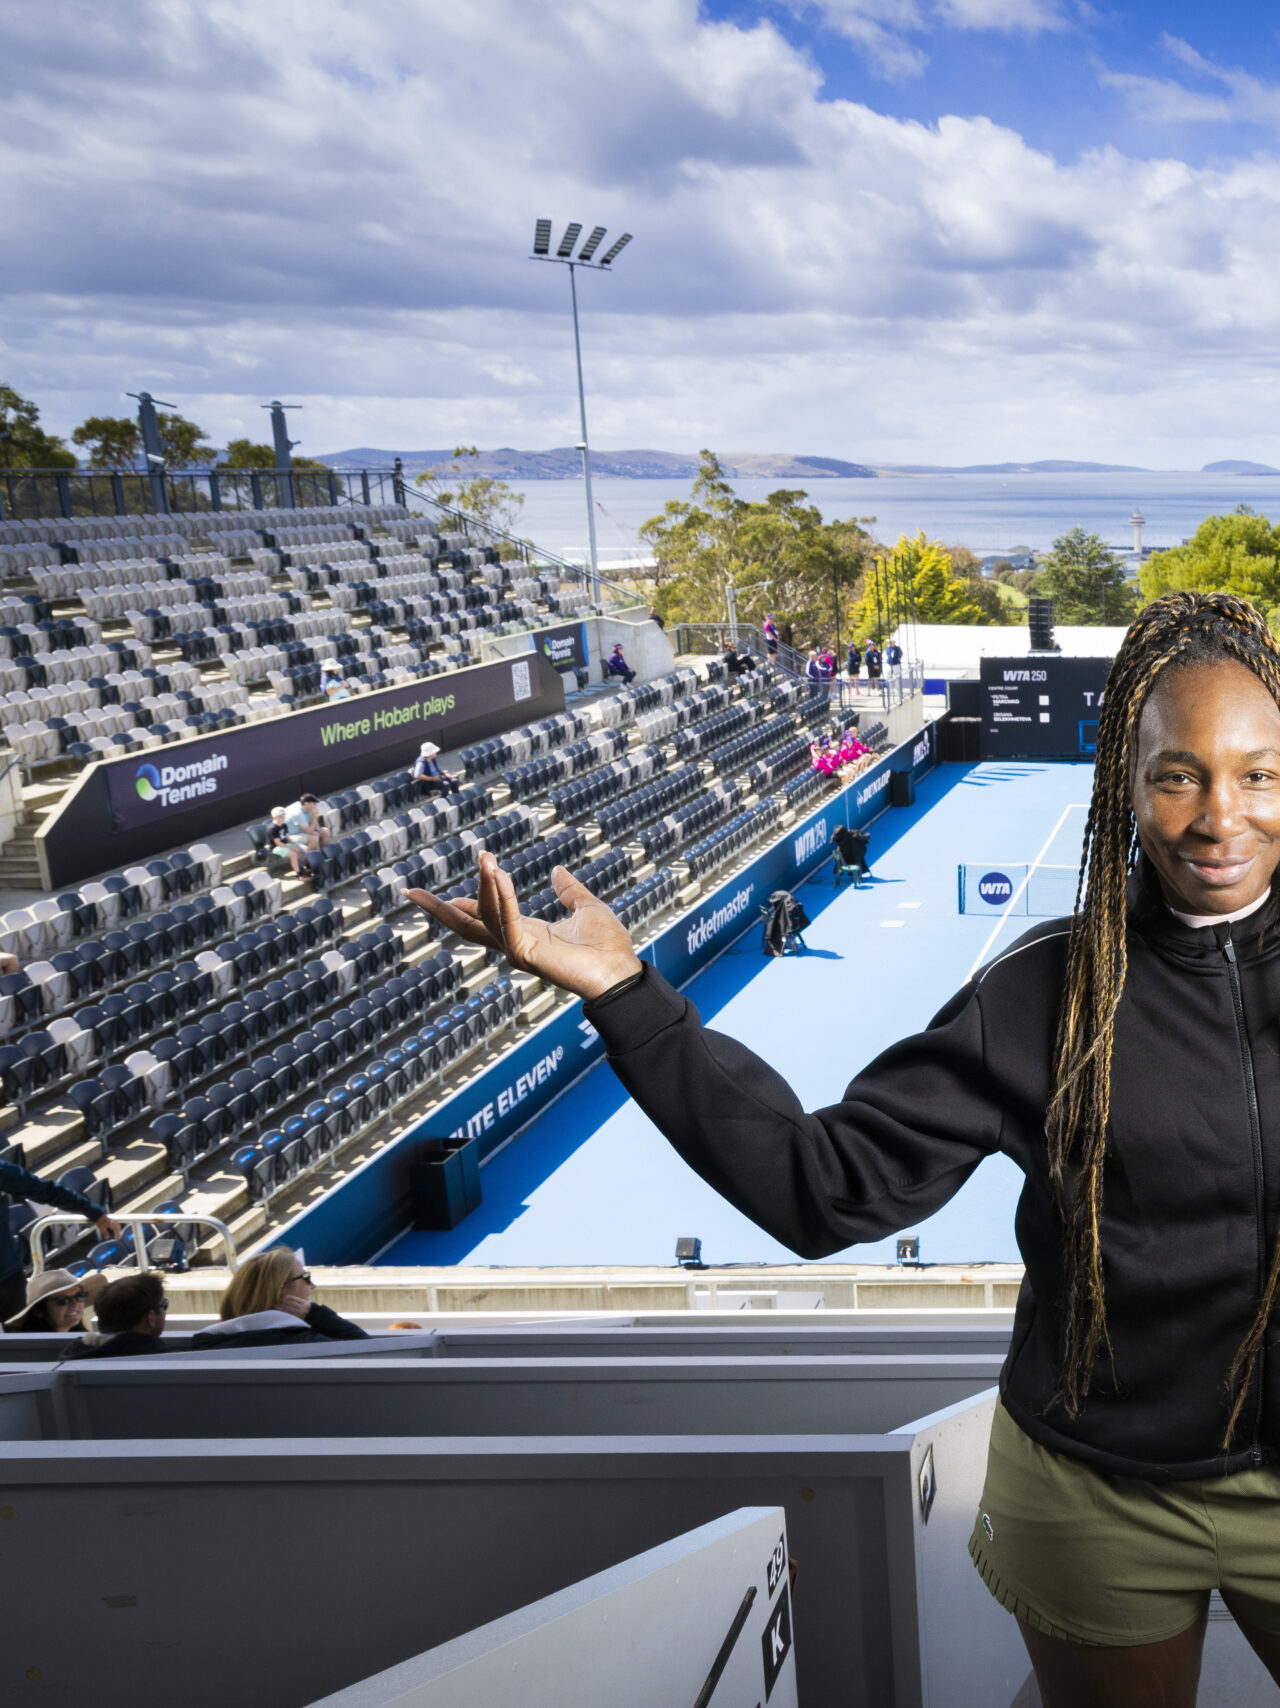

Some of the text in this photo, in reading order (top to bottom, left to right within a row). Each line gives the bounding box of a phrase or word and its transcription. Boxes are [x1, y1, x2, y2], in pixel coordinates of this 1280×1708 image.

[1003, 670, 1047, 681] WTA 250
[320, 694, 455, 747] Where Hobart plays
[161, 753, 228, 787] Domain
[159, 776, 217, 807] Tennis
[795, 818, 827, 867] WTA 250
[980, 883, 1010, 895] WTA
[769, 1541, 783, 1587] 49
[771, 1611, 784, 1667] K
